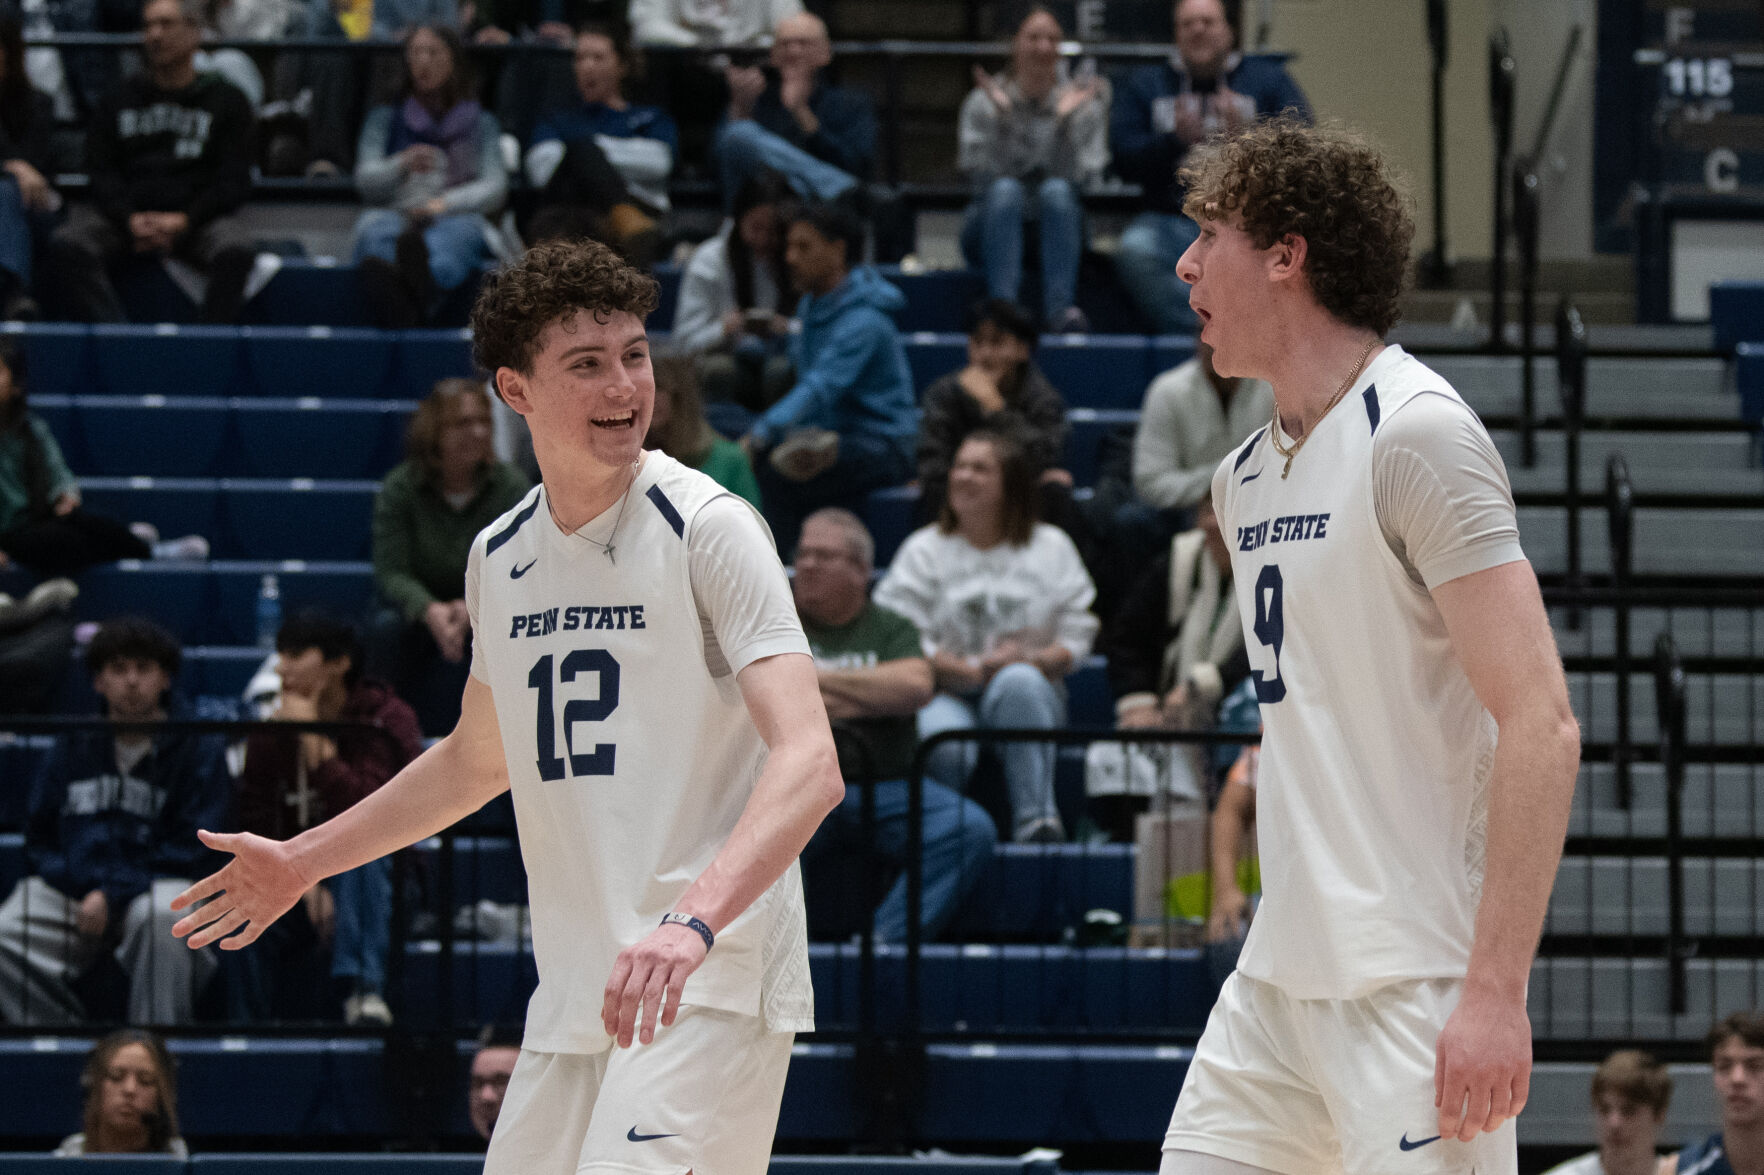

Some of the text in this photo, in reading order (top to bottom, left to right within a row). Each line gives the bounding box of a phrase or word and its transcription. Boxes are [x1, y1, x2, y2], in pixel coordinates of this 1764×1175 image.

[1665, 7, 1696, 46] F
[1667, 59, 1734, 97] 115
[1705, 148, 1740, 192] C
[1270, 513, 1331, 543] STATE
[510, 604, 646, 639] PENN STATE
[1250, 563, 1287, 703] 9
[527, 648, 621, 783] 12
